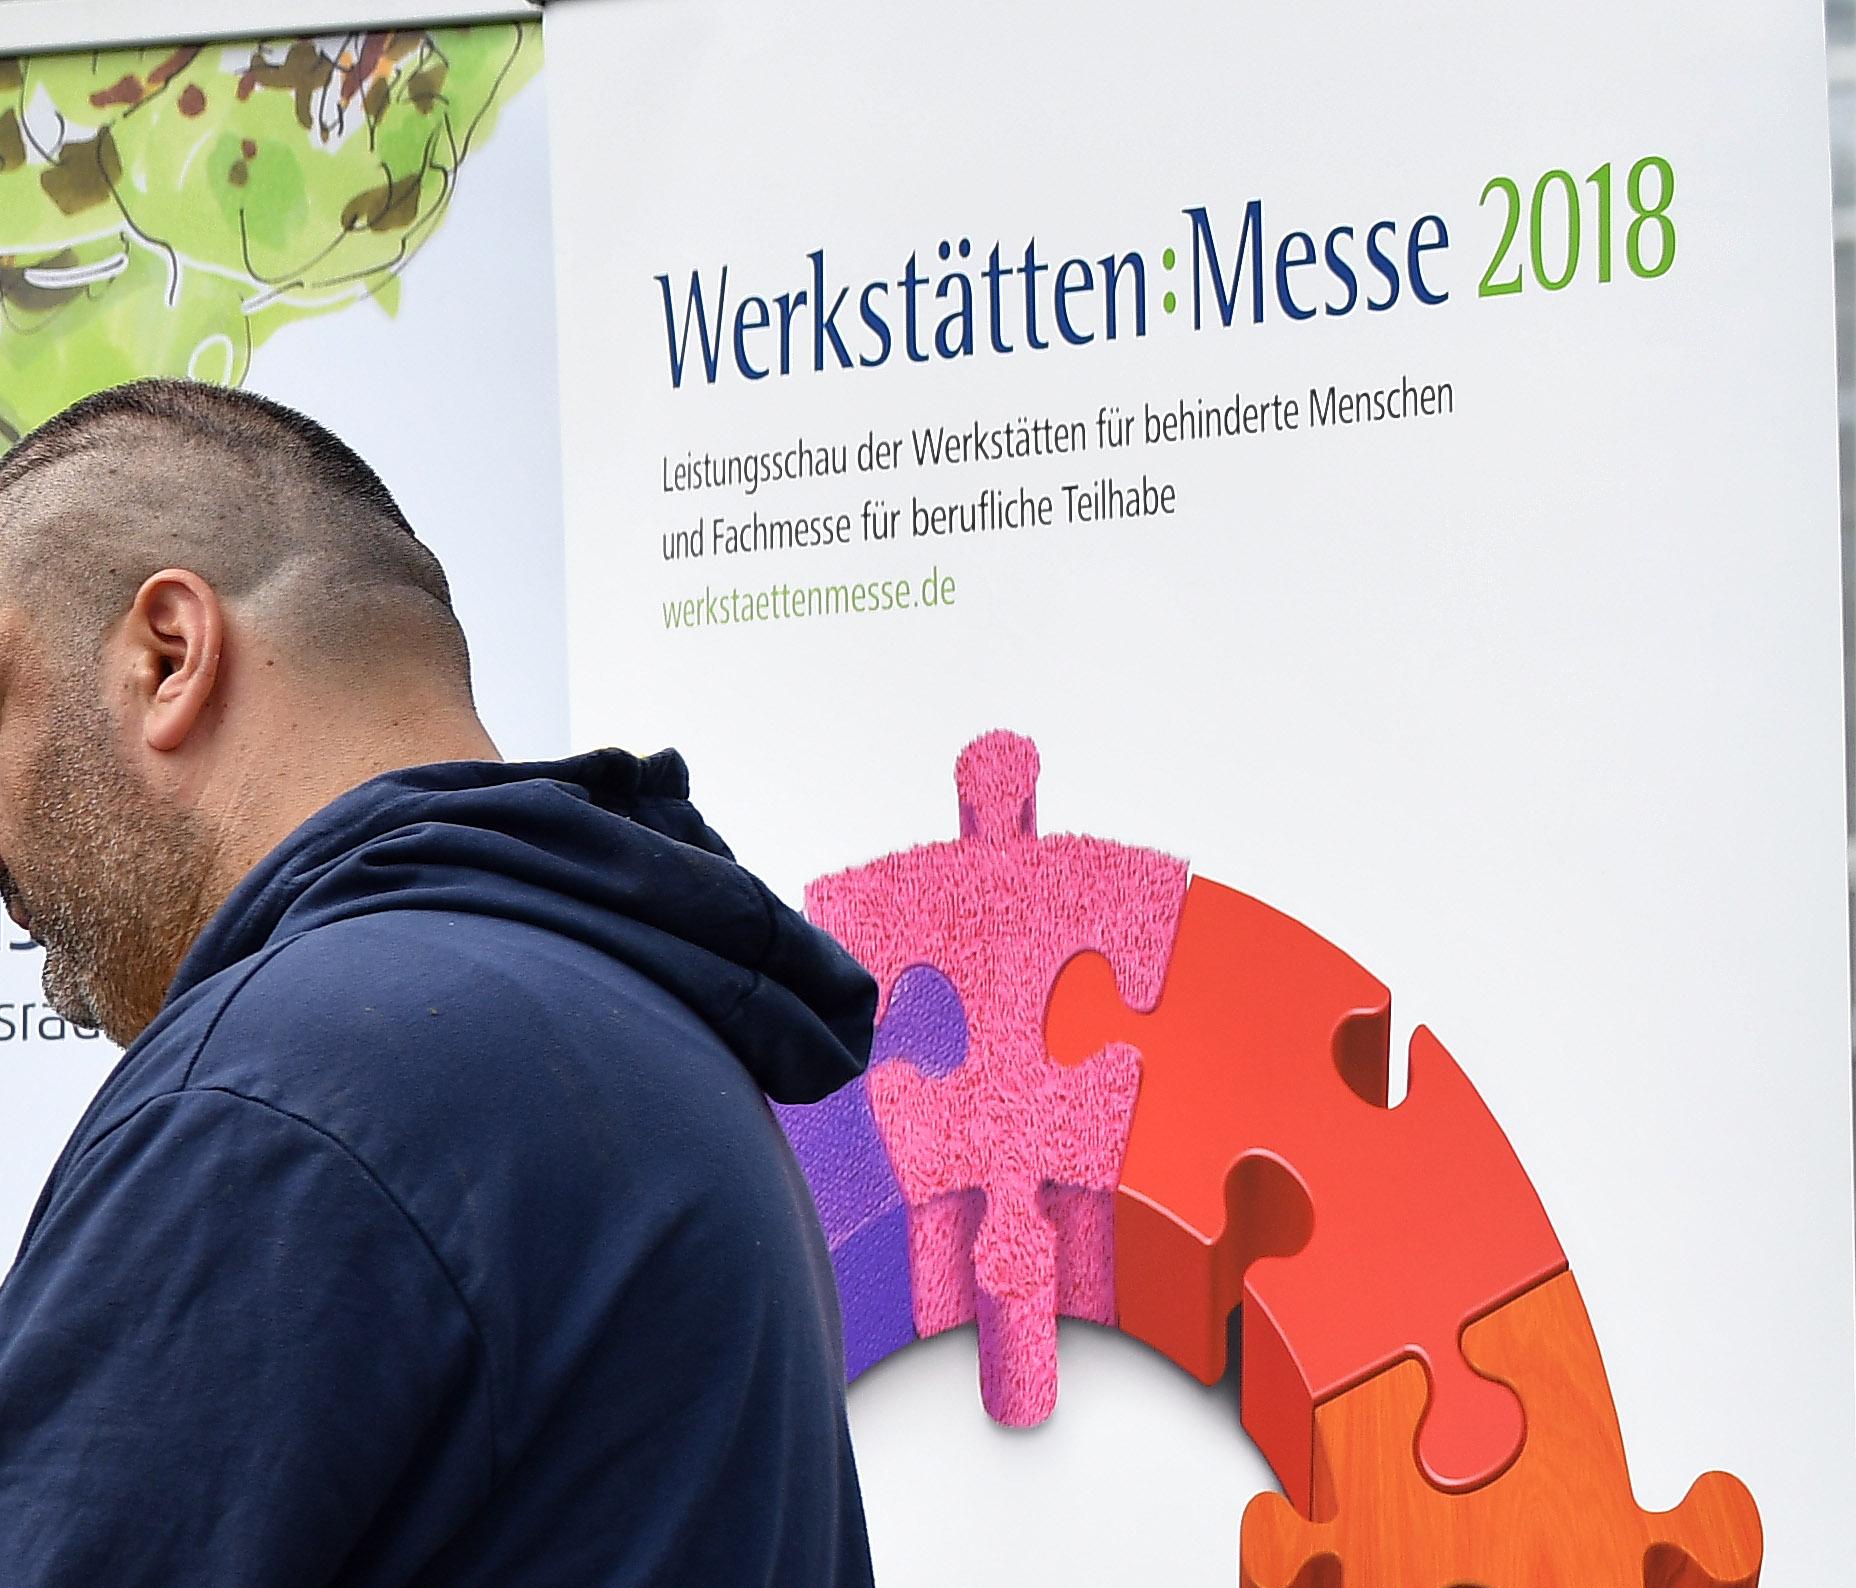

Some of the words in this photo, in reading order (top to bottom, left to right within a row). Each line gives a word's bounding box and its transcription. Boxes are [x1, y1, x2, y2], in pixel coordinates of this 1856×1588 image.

[653, 199, 1449, 389] Werkstätten:Messe
[1477, 155, 1677, 298] 2018
[662, 438, 847, 495] Leistungsschau
[857, 431, 903, 472] der
[911, 416, 1086, 466] Werkstätten
[1096, 407, 1135, 449] für
[1145, 393, 1299, 444] behinderte
[1309, 375, 1454, 427] Menschen
[662, 517, 704, 560] und
[713, 511, 852, 556] Fachmesse
[860, 500, 901, 541] für
[912, 487, 1053, 537] berufliche
[1061, 475, 1176, 523] Teilhabe
[662, 565, 956, 629] werkstaettenmesse.de
